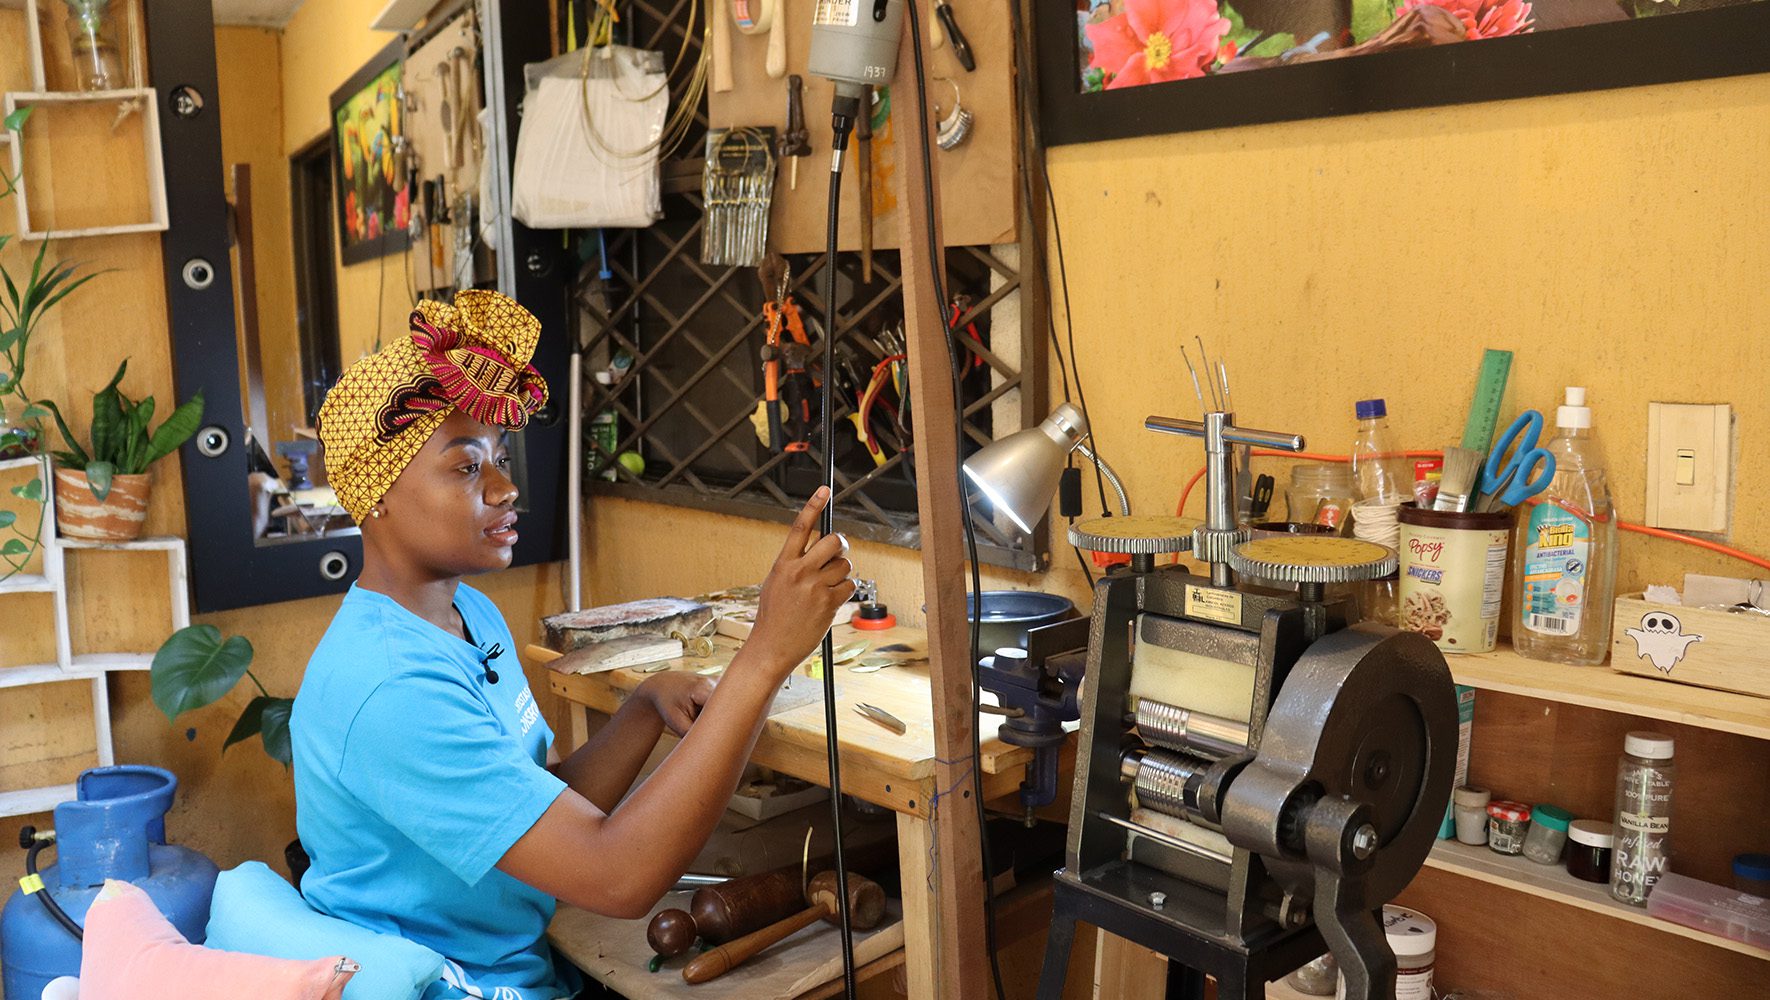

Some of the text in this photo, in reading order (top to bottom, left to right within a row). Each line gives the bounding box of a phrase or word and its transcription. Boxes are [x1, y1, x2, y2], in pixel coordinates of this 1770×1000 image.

[1408, 538, 1444, 562] Popsy
[1408, 566, 1442, 581] SNICKERS
[1621, 817, 1669, 830] VANILLA BEAN
[1622, 834, 1664, 849] infed
[1616, 849, 1667, 873] RAW
